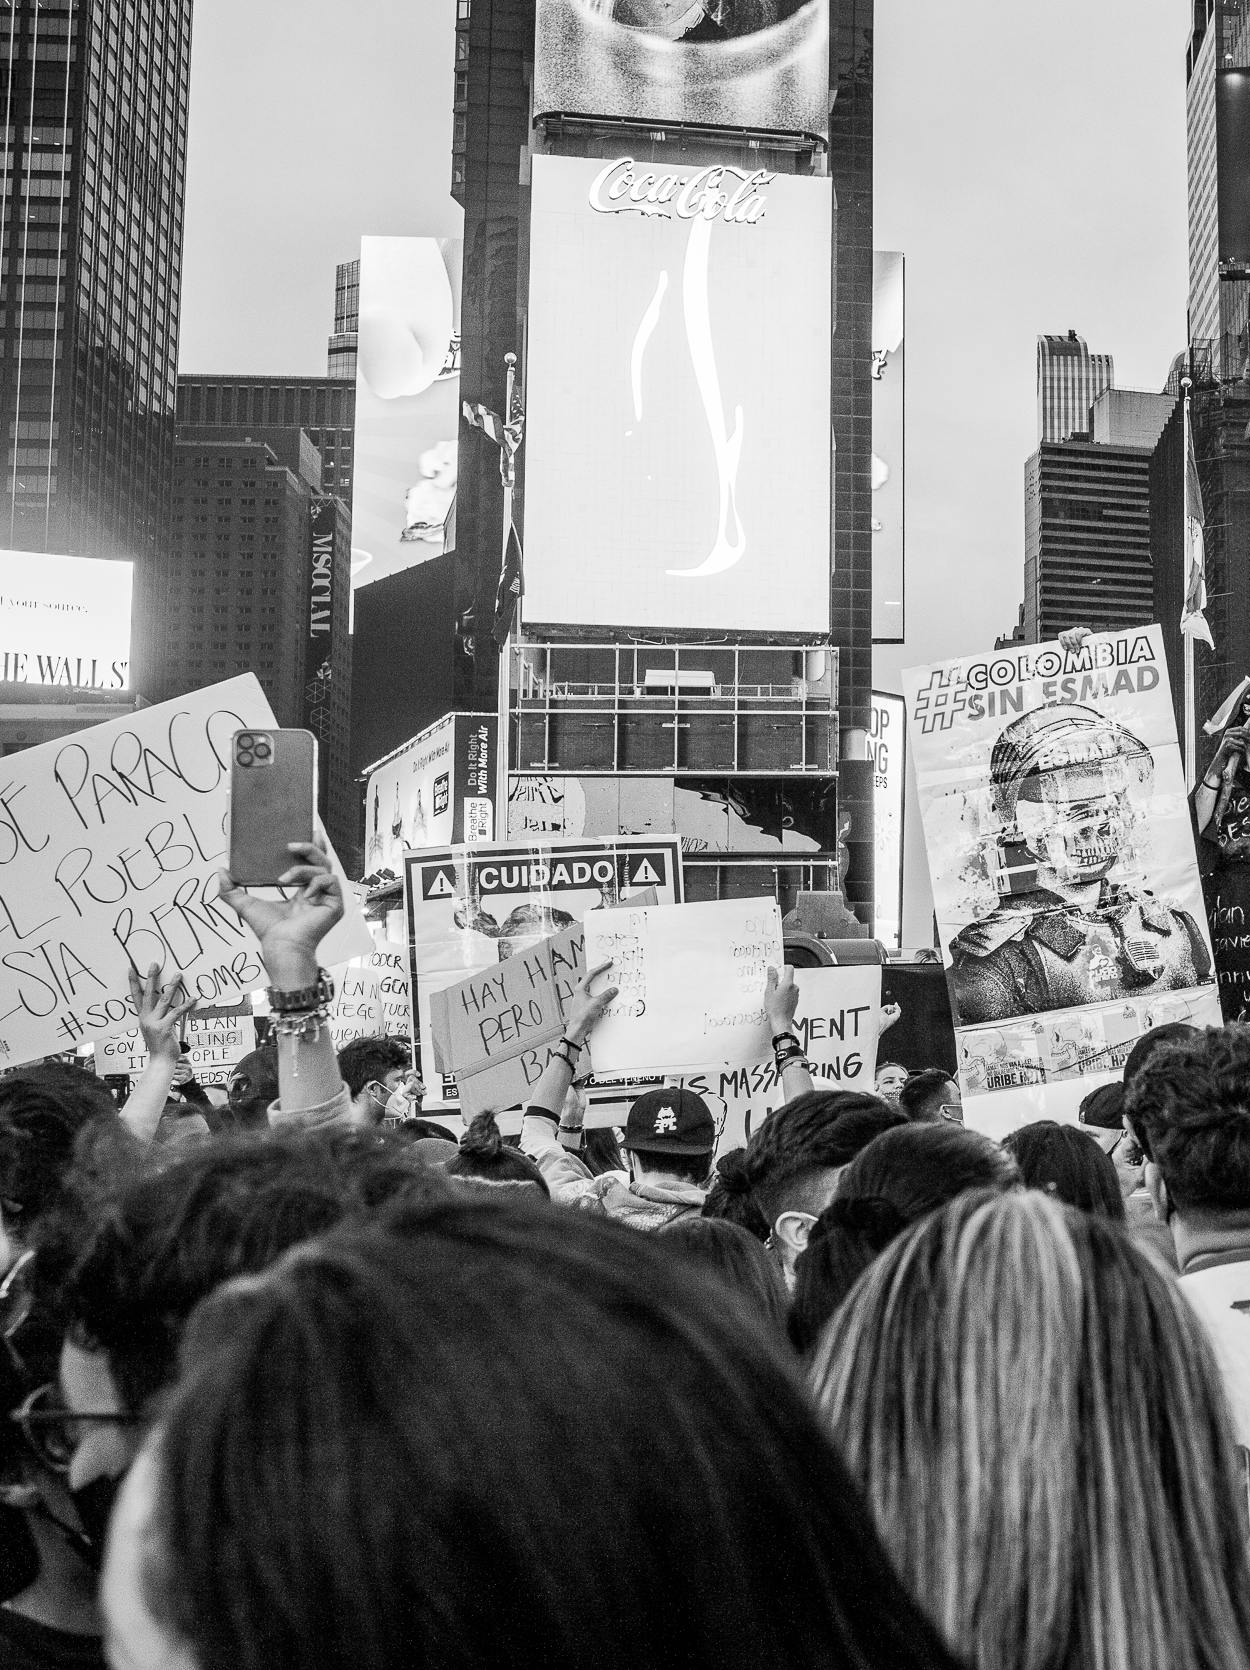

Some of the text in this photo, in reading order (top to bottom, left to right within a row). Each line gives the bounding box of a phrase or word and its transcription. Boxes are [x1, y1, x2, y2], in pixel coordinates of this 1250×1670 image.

[37, 654, 104, 688] WALL
[967, 664, 1160, 721] SIN ESMAD
[468, 734, 479, 786] Do It Right
[478, 725, 488, 794] With More Air
[468, 802, 478, 841] Breathe
[478, 803, 488, 828] Right
[55, 812, 229, 917] PUEBL
[479, 860, 614, 889] CUIDADO
[0, 939, 108, 1022] STA
[461, 972, 509, 1015] HAY
[104, 1040, 135, 1056] GOV
[478, 999, 543, 1056] PERO
[987, 1071, 1018, 1089] URIBE
